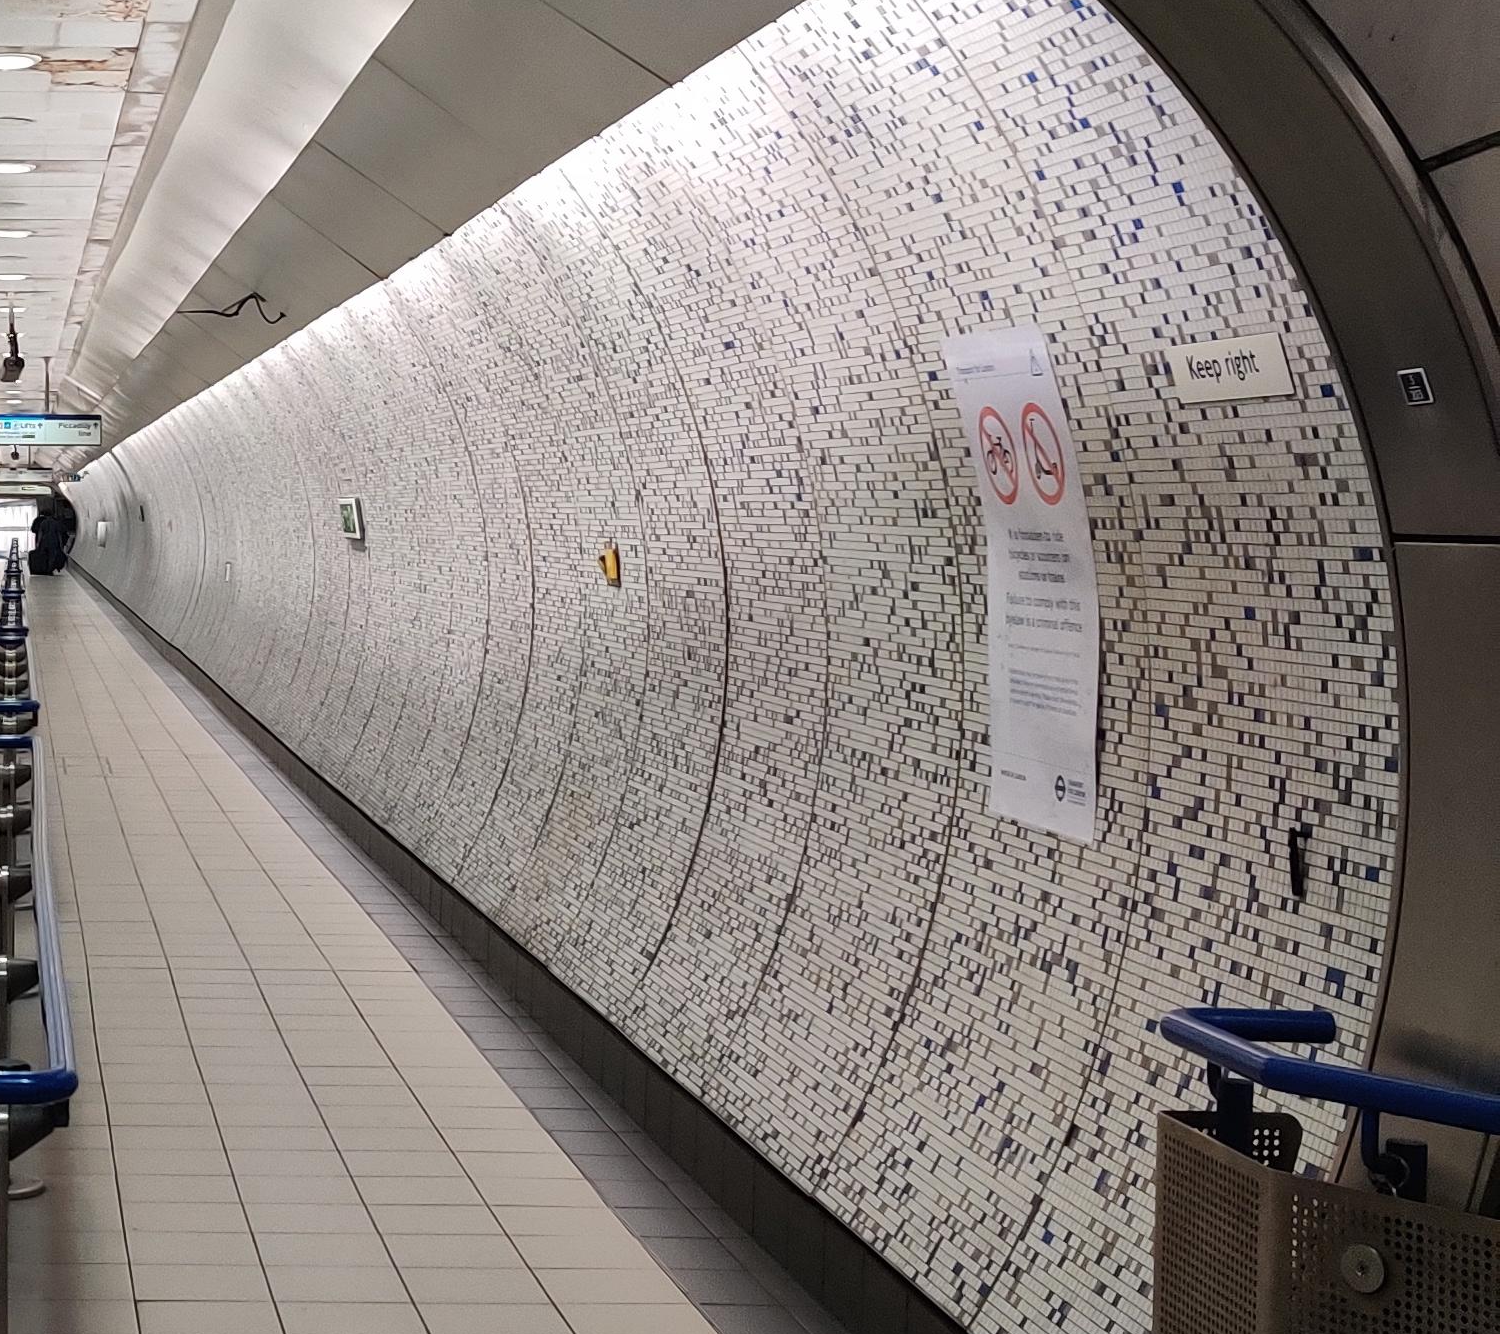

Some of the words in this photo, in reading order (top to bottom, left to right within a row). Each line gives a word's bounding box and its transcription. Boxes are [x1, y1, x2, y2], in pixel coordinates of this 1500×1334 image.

[1185, 355, 1222, 383] Keep
[1225, 349, 1260, 381] right
[58, 422, 92, 430] Piccadilly
